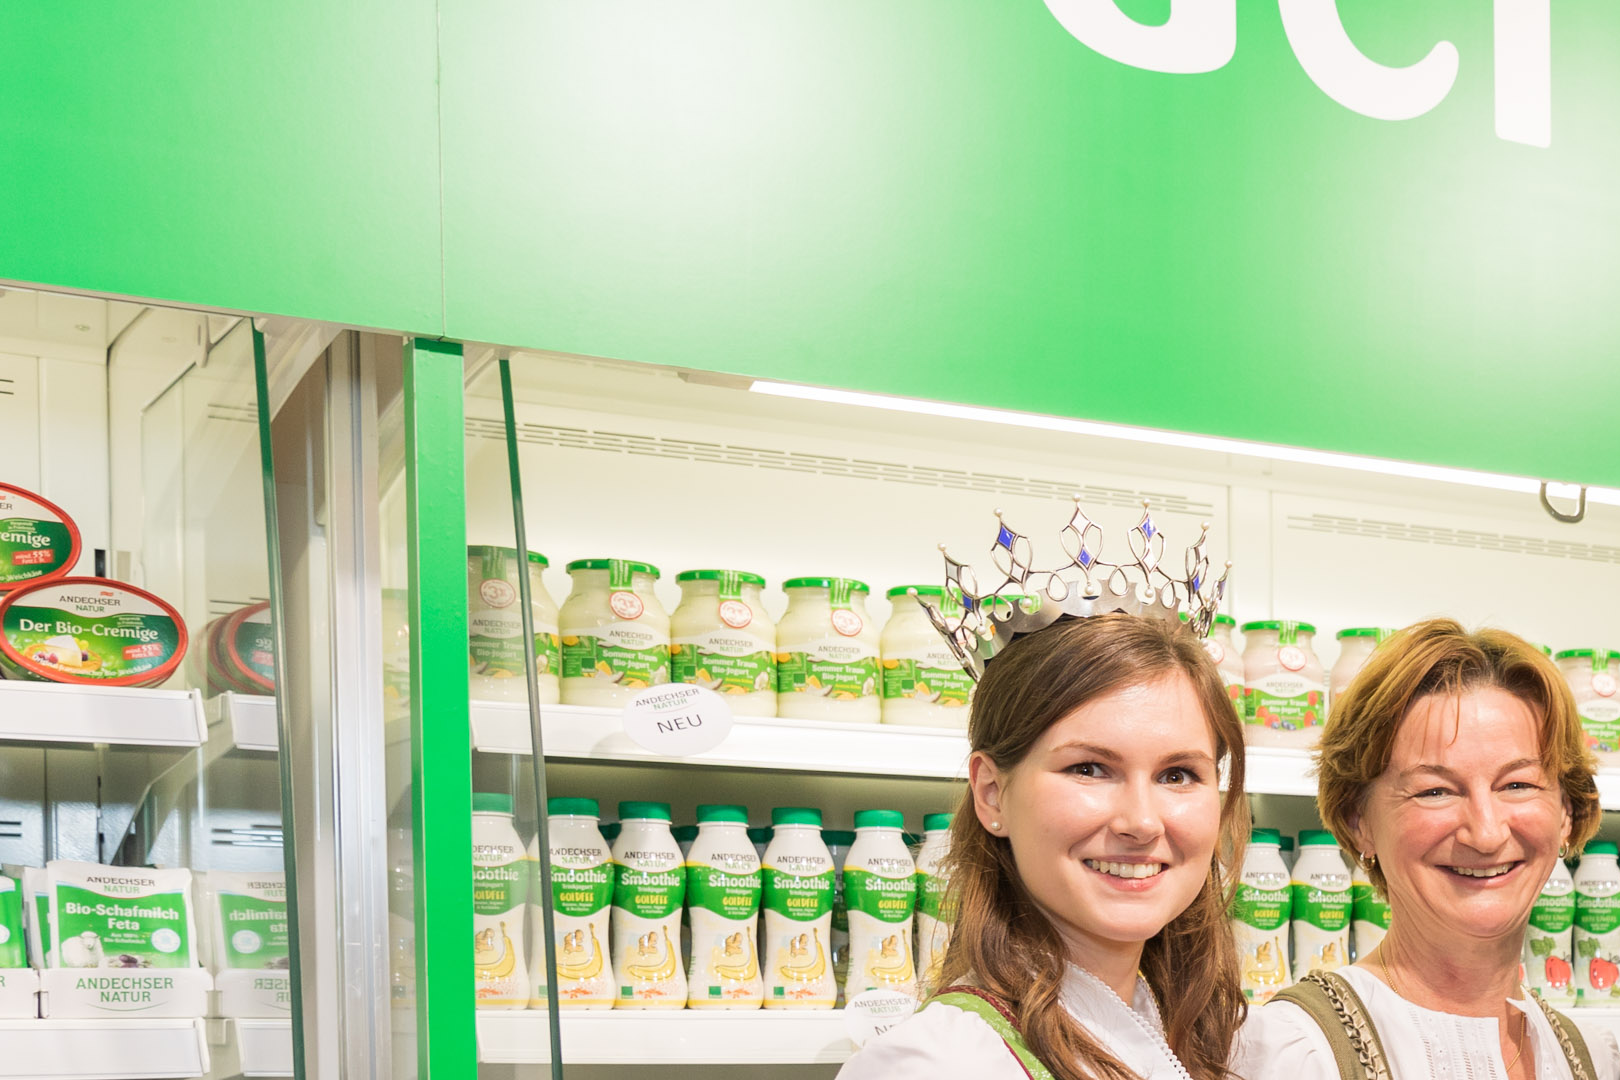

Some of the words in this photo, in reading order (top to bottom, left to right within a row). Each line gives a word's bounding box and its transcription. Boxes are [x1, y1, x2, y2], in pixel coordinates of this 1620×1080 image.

[59, 595, 121, 606] ANDECHSER
[75, 604, 105, 613] NATUR
[19, 618, 52, 633] Der
[55, 621, 159, 642] Bio-Cremige
[709, 638, 753, 647] ANDECHSER
[635, 688, 700, 707] ANDECHSER
[653, 698, 688, 711] NATUR
[657, 714, 702, 734] NEU
[624, 851, 676, 860] ANDECHSER
[86, 876, 155, 887] ANDECHSER
[551, 870, 607, 884] Smoothie
[621, 872, 680, 887] Smoothie
[709, 875, 761, 888] Smoothie
[774, 876, 830, 890] Smoothie
[103, 885, 140, 894] NATUR
[865, 878, 916, 892] Smoothie
[66, 902, 179, 921] Bio-Schafmilch
[107, 918, 140, 931] Feta
[76, 977, 174, 990] ANDECHSER
[100, 991, 151, 1002] NATUR
[854, 998, 911, 1009] ANDECHSER
